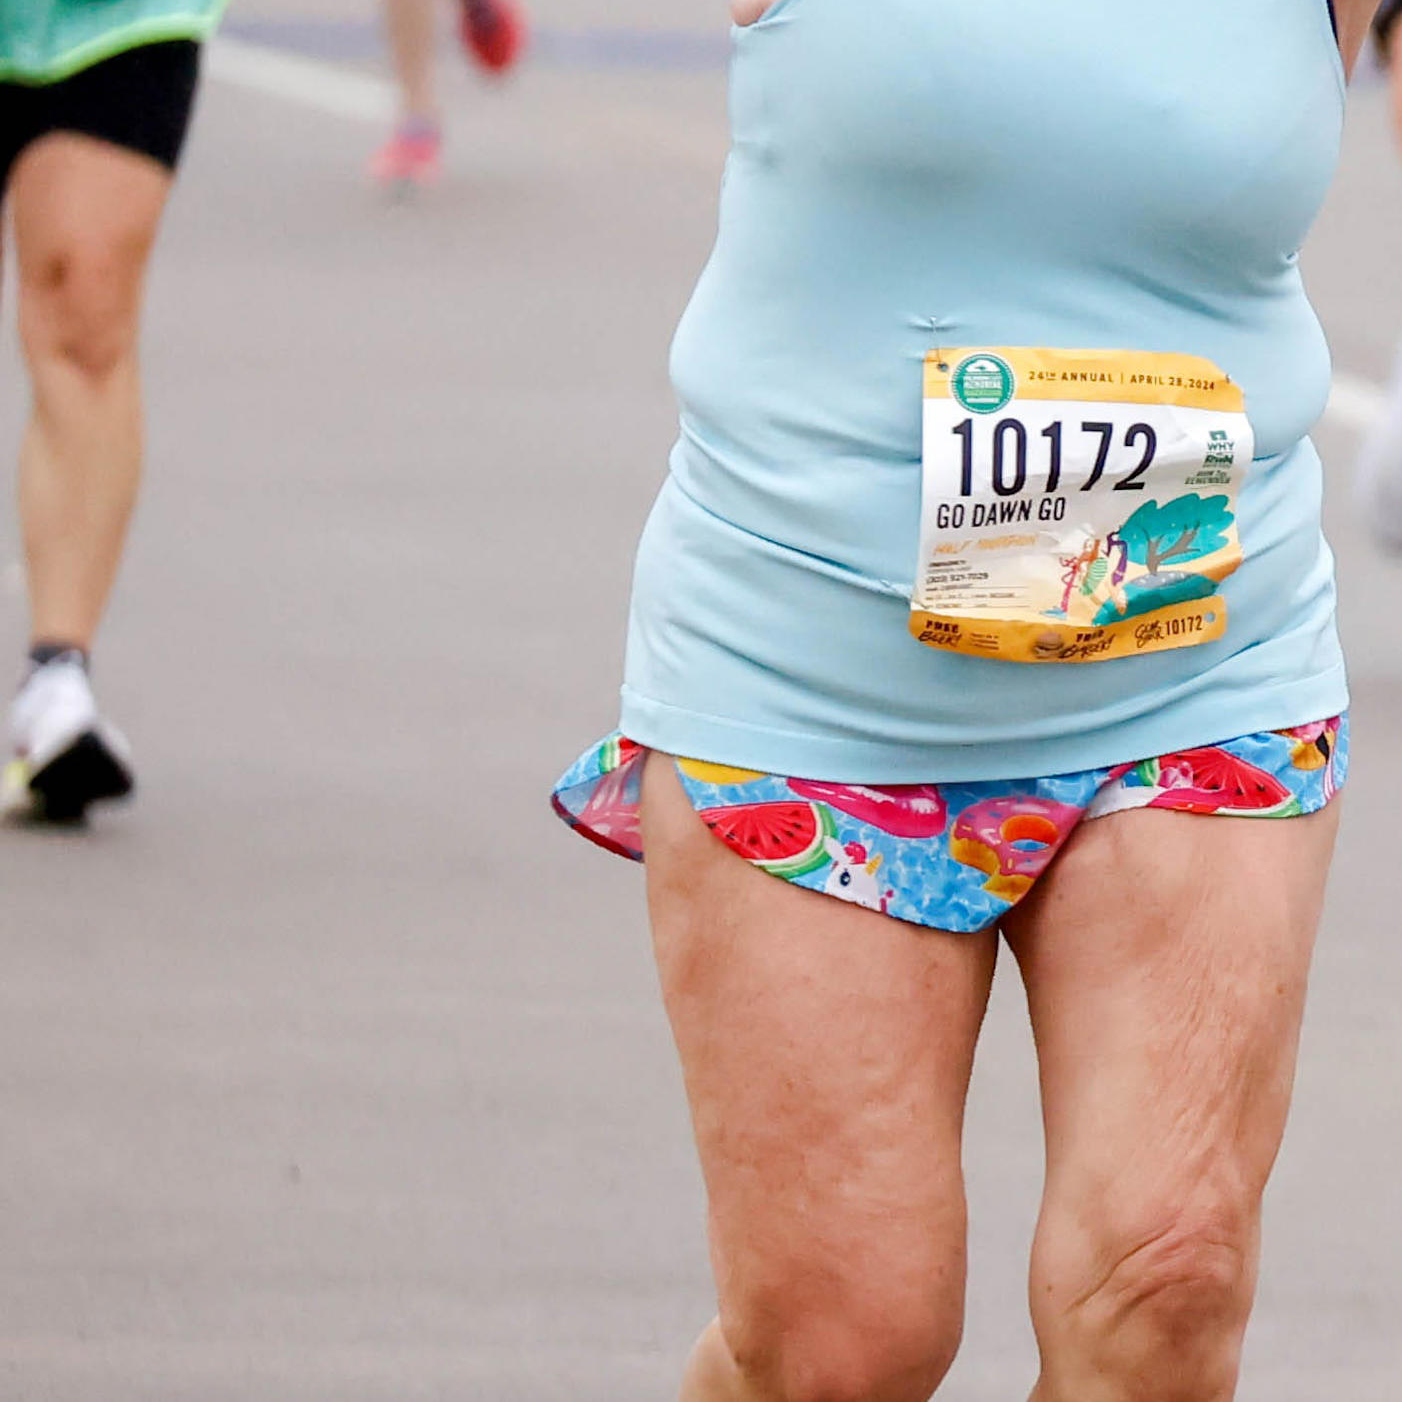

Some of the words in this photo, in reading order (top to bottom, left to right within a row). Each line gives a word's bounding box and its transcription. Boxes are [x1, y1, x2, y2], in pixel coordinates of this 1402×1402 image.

[1061, 371, 1114, 383] ANNUAL
[1130, 374, 1165, 386] APRIL
[952, 416, 1158, 498] 10172
[1207, 441, 1235, 451] WHY
[936, 503, 965, 530] GO
[971, 499, 1033, 528] DAWN
[1038, 496, 1067, 522] GO
[1165, 615, 1203, 637] 10172
